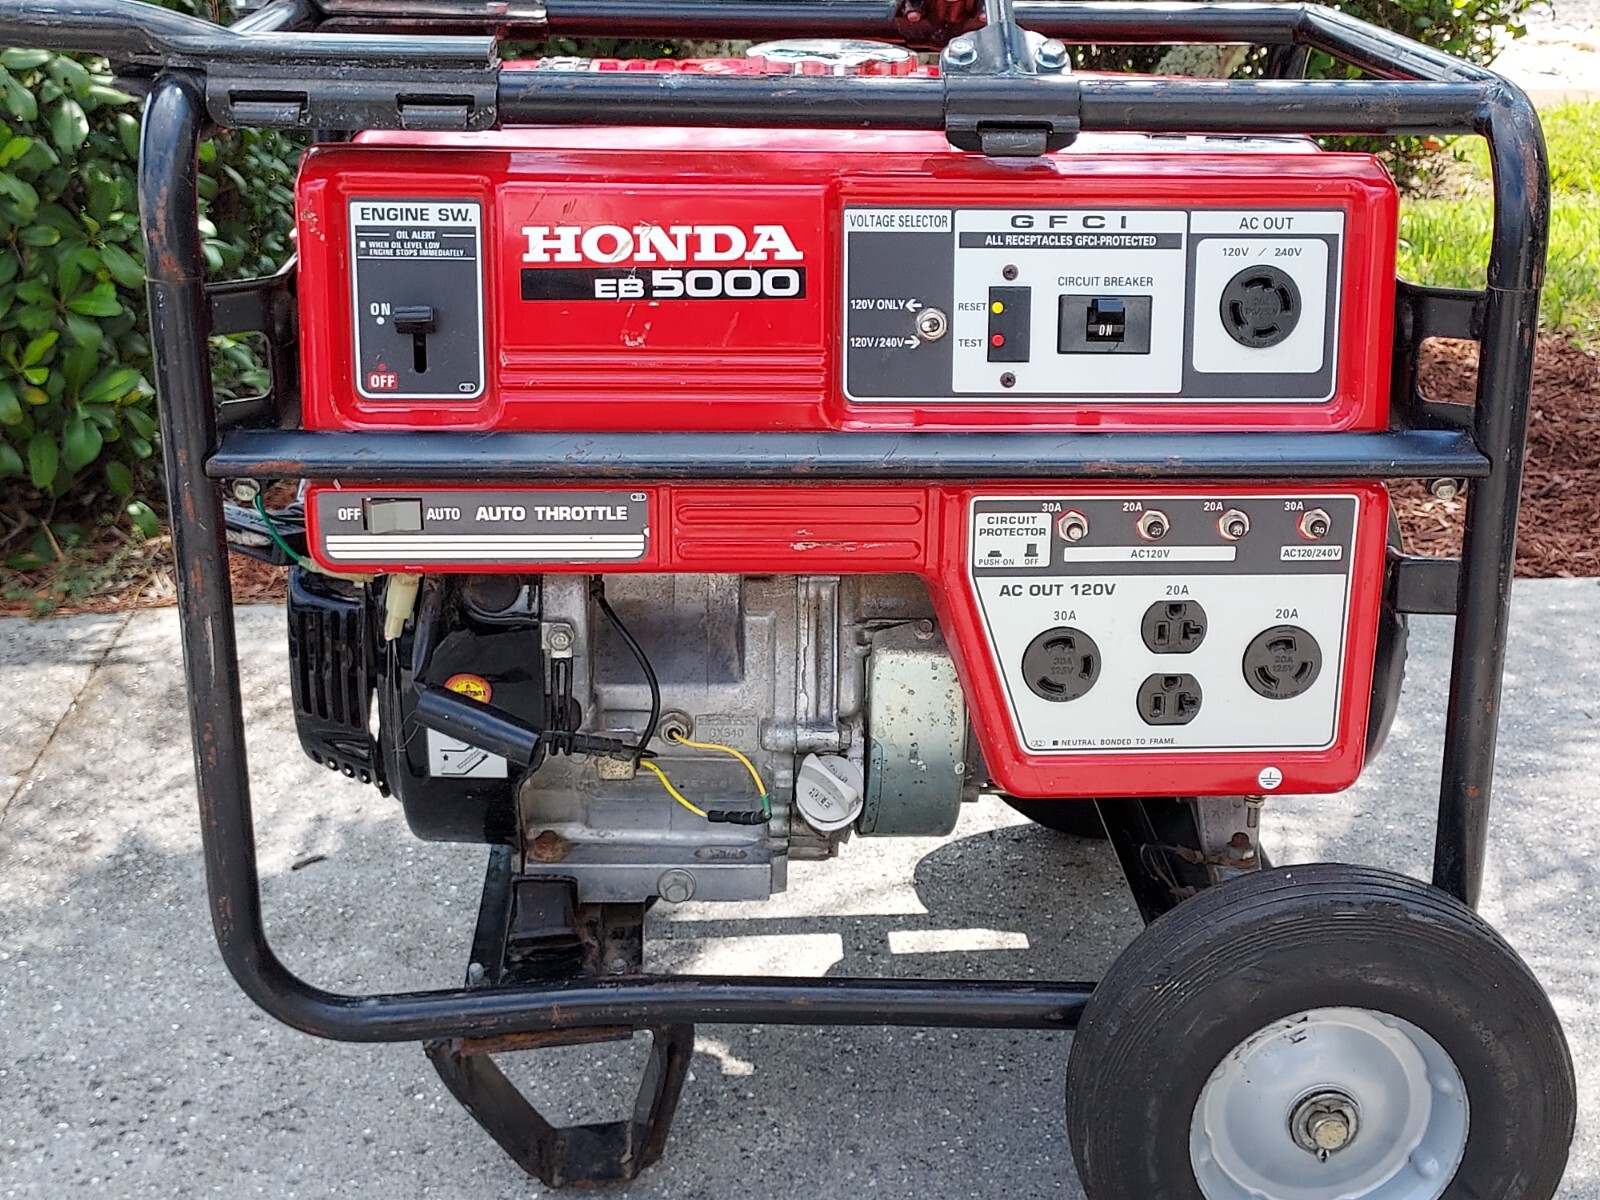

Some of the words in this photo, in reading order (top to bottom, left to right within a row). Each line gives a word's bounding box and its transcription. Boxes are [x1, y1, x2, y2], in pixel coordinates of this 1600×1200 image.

[360, 207, 430, 221] ENGINE
[438, 208, 473, 222] SW.
[849, 214, 896, 228] VOLTAGE
[898, 214, 948, 228] SELECTOR
[1239, 217, 1259, 230] AC
[1263, 217, 1294, 230] OUT
[396, 231, 409, 240] OIL
[411, 231, 437, 240] ALERT
[985, 234, 1004, 246] ALL
[1005, 235, 1073, 246] RECEPTACLES
[1075, 235, 1157, 247] GFCI-PROTECTED
[368, 241, 390, 249] WHEN
[391, 241, 402, 249] OIL
[403, 241, 423, 249] LEVEL
[521, 225, 804, 263] HONDA
[1222, 247, 1250, 257] 120V
[1274, 247, 1303, 257] 240V
[1057, 276, 1100, 287] CIRCUIT
[1103, 276, 1154, 287] BREAKER
[370, 302, 391, 316] ON
[850, 300, 875, 310] 120V
[877, 300, 905, 310] ONLY
[958, 303, 987, 311] RESET
[1098, 324, 1113, 336] ON
[958, 339, 984, 348] TEST
[370, 375, 395, 388] OFF
[1041, 502, 1062, 513] 30A
[1122, 502, 1143, 512] 20A
[1203, 501, 1224, 512] 20A
[1284, 501, 1304, 511] 30A
[338, 508, 361, 521] OFF
[426, 507, 461, 521] AUTO
[475, 506, 526, 521] AUTO
[534, 506, 628, 521] THROTTLE
[986, 516, 1038, 525] CIRCUIT
[978, 527, 1047, 537] PROTECTOR
[1152, 527, 1162, 536] 20
[1232, 527, 1243, 536] 20
[1314, 526, 1325, 534] 30
[1130, 549, 1171, 559] AC120V
[1282, 549, 1341, 558] AC120/240V
[1024, 558, 1039, 566] OFF
[999, 584, 1023, 597] AC
[1029, 584, 1064, 597] OUT
[1070, 583, 1117, 596] 120V
[1166, 584, 1190, 596] 20A
[1053, 610, 1077, 621] 30A
[1275, 608, 1299, 619] 20A
[1061, 739, 1097, 747] NEUTRAL
[1100, 738, 1132, 746] BONDED
